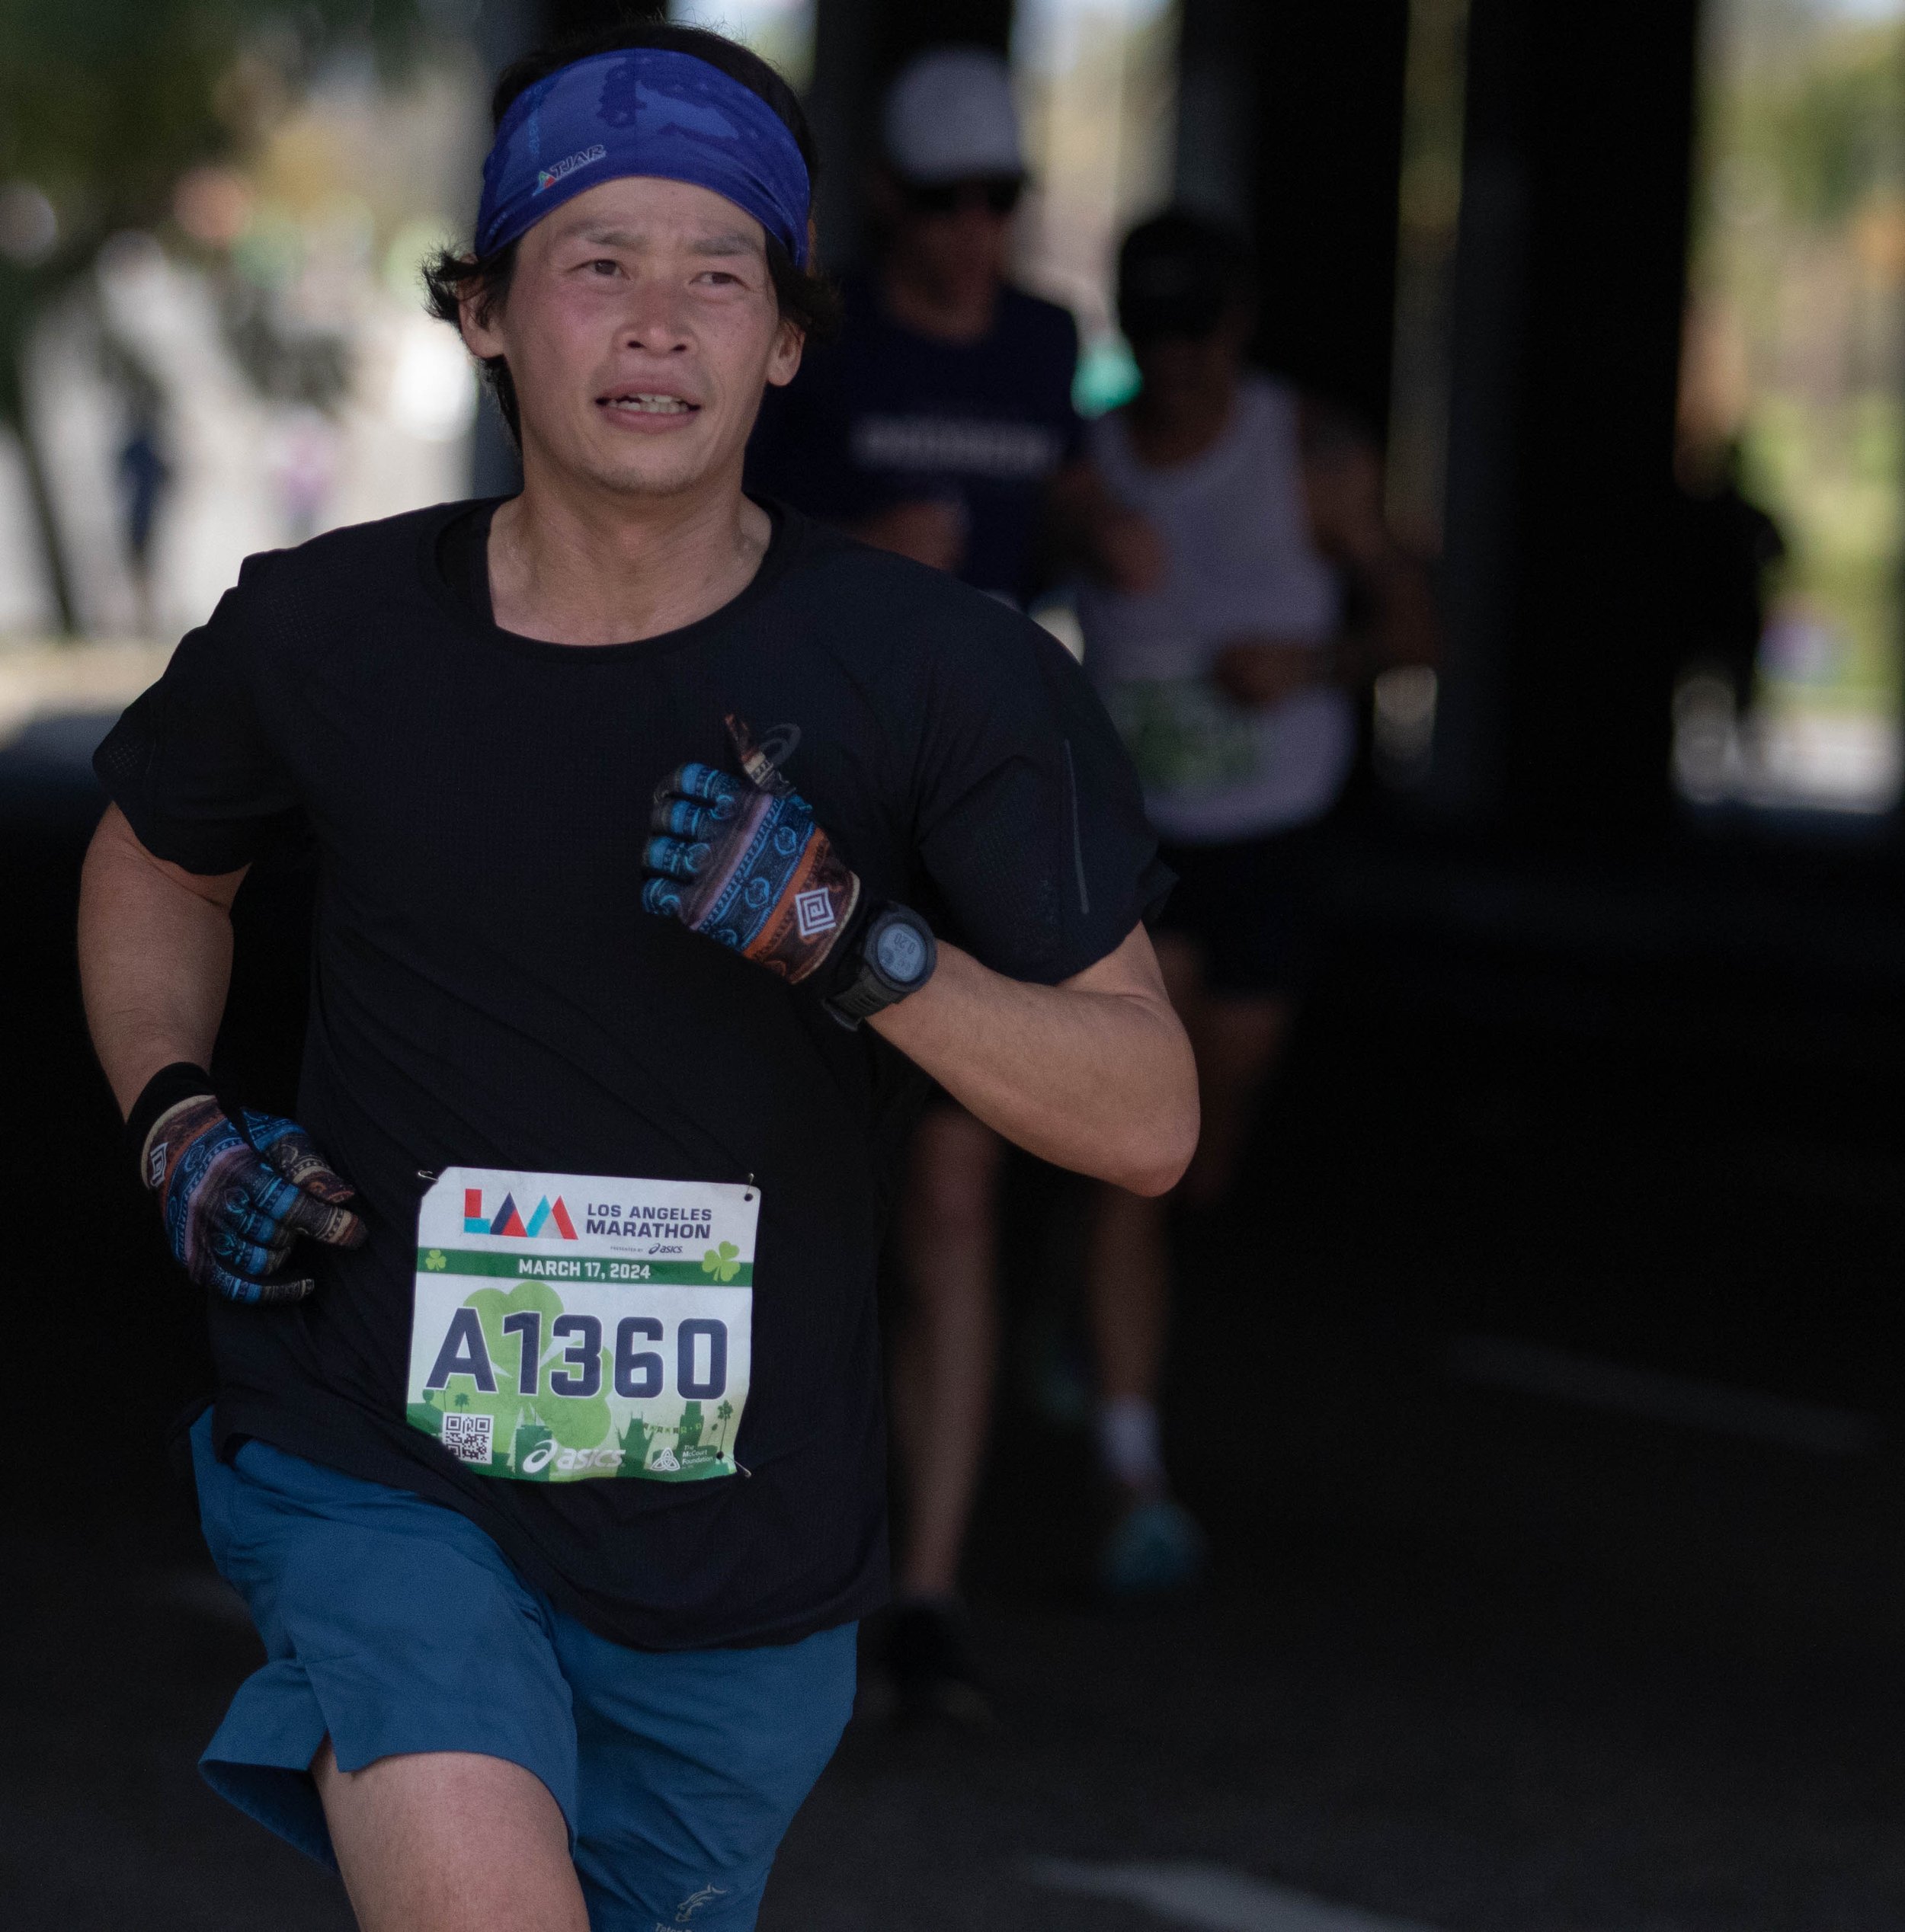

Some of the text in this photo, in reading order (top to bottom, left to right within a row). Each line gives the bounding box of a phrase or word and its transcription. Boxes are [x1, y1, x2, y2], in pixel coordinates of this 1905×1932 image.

[588, 1203, 712, 1221] LOS ANGELES
[586, 1220, 711, 1239] MARATHON
[519, 1259, 651, 1280] MARCH 17, 2024
[425, 1307, 728, 1400] A1360
[682, 1449, 707, 1457] McCourt
